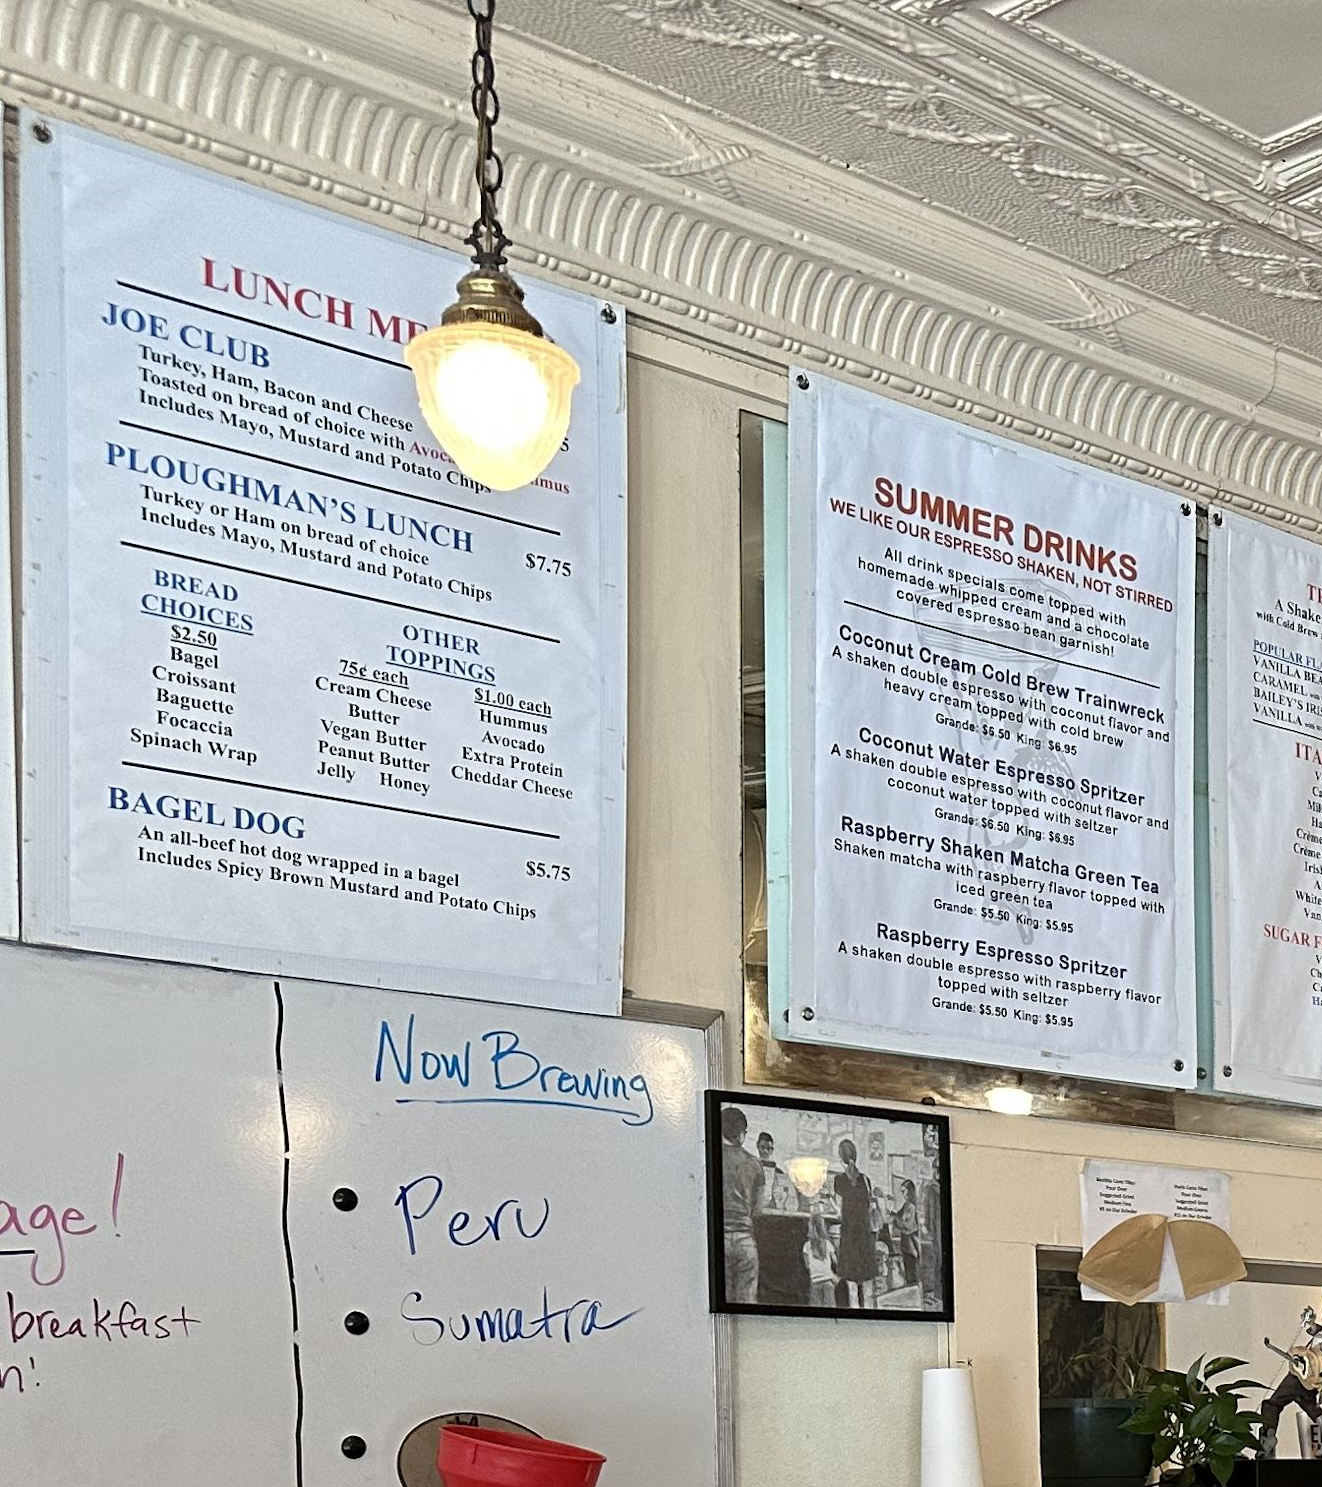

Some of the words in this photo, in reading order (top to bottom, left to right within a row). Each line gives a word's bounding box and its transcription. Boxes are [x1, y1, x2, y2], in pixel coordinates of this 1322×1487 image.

[201, 258, 355, 330] LUNCH
[102, 302, 170, 339] JOE
[179, 325, 271, 369] CLUB
[105, 442, 358, 525] PLOUGHMAN'S
[366, 506, 473, 554] LUNCH
[874, 477, 1014, 545] SUMMER
[1023, 523, 1138, 581] DRINKS
[525, 552, 572, 578] $7.75
[830, 498, 857, 517] WE
[860, 507, 893, 530] LIKE
[897, 519, 931, 541] OUR
[934, 530, 1014, 566] ESPRESSO
[1017, 555, 1079, 589] SHAKEN,
[1083, 576, 1112, 594] NOT
[1115, 586, 1173, 613] STIRRED
[154, 569, 238, 602] BREAD
[141, 594, 254, 633] CHOICES
[1274, 600, 1283, 612] A
[170, 625, 217, 648] $2.50
[402, 624, 480, 656] OTHER
[170, 646, 219, 670] Bagel
[386, 644, 496, 683] TOPPINGS
[839, 625, 915, 660] Coconut
[919, 647, 976, 676] Cream
[982, 663, 1021, 688] Cold
[1026, 675, 1070, 699] Brew
[1074, 688, 1165, 724] Trainwreck
[152, 665, 236, 694] Croissant
[156, 688, 234, 716] Baguette
[156, 710, 233, 737] Focaccia
[130, 728, 202, 756] Spinach
[208, 742, 258, 765] Wrap
[859, 728, 933, 759] Coconut
[939, 746, 990, 773] Water
[995, 759, 1075, 792] Espresso
[1080, 778, 1145, 806] Spritzer
[108, 786, 226, 828] BAGEL
[233, 809, 306, 840] DOG
[526, 859, 571, 882] $5.75
[842, 816, 935, 853] Raspberry
[941, 837, 1004, 863] Shaken
[1010, 852, 1070, 877] Matcha
[1075, 864, 1125, 887] Green
[1131, 875, 1159, 894] Tea
[1264, 924, 1310, 947] SUGAR
[376, 1014, 470, 1085] Now
[484, 1032, 652, 1119] Brewing
[397, 1176, 548, 1255] Peru
[10, 1292, 201, 1342] breakfast
[403, 1289, 644, 1345] Sumatra
